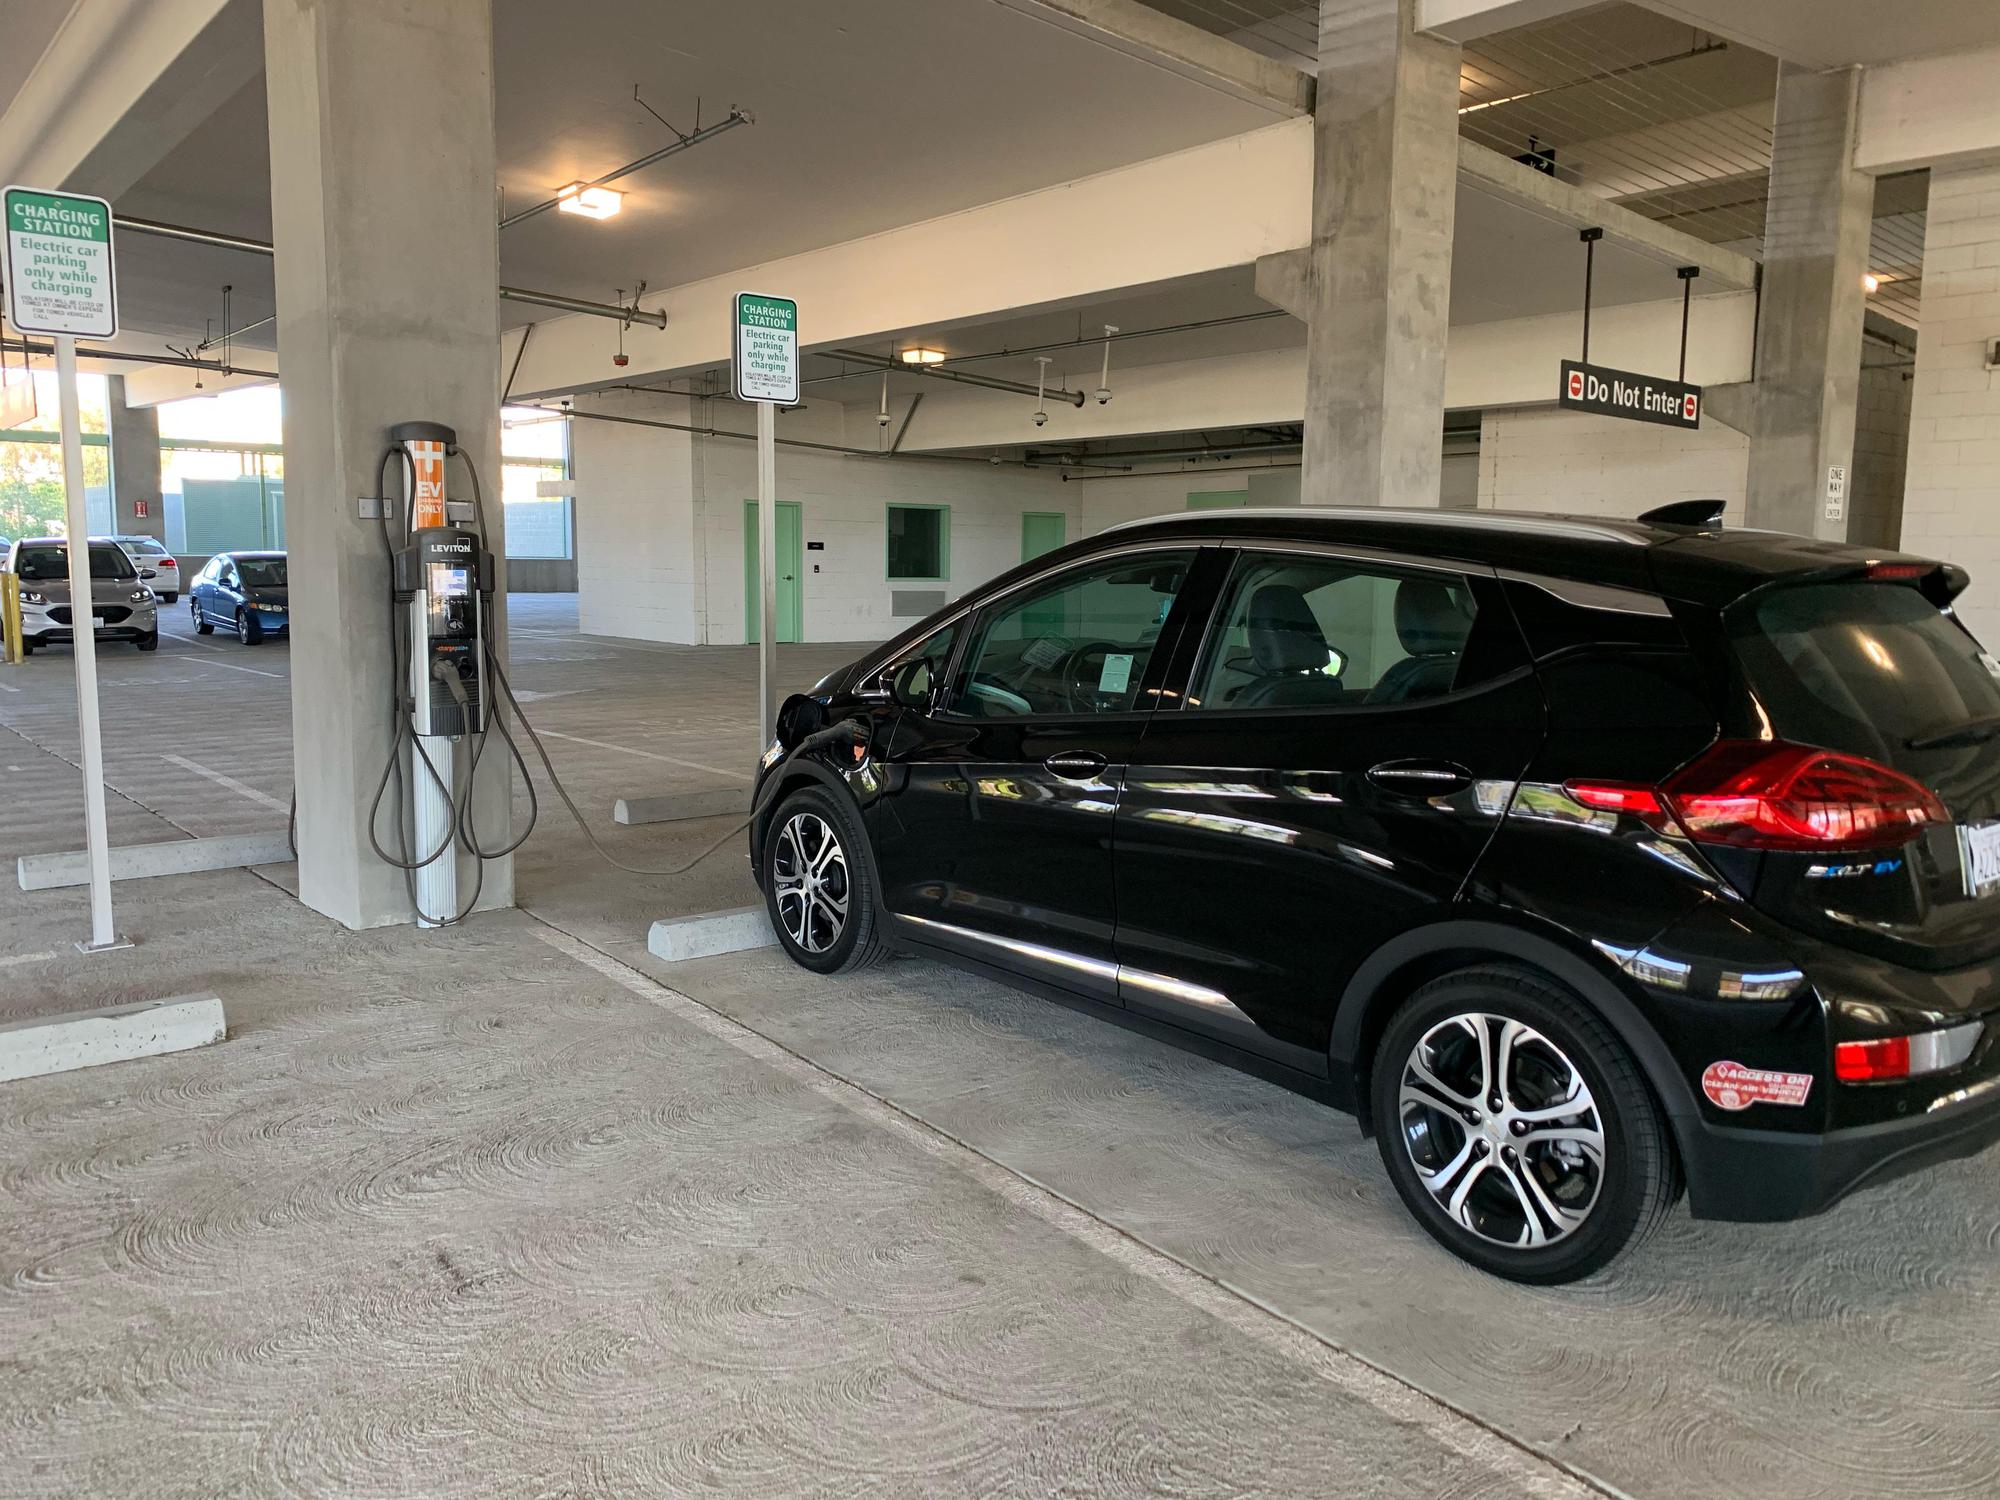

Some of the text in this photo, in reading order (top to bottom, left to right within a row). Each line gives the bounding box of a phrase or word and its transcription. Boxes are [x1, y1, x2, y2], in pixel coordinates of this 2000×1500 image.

[14, 203, 100, 226] CHARGING
[24, 218, 92, 238] STATION
[20, 237, 98, 257] Electric car
[33, 253, 87, 270] parking
[24, 267, 97, 284] only while
[31, 280, 92, 298] charging
[743, 303, 792, 319] CHARGING
[748, 315, 787, 328] STATION
[746, 329, 790, 342] Electric car
[753, 340, 783, 353] parking
[747, 350, 789, 362] only while
[751, 360, 786, 373] charging
[1587, 375, 1682, 415] Do Not Enter
[1830, 468, 1843, 480] ONE
[416, 481, 441, 497] EV
[1829, 482, 1842, 493] WAY
[417, 504, 442, 513] ONLY
[431, 544, 471, 553] LEVITON
[1873, 859, 1902, 876] EV
[1727, 1069, 1809, 1085] ACCESS OK
[1705, 1079, 1738, 1090] CLEAN
[1741, 1084, 1759, 1093] AIR
[1762, 1086, 1804, 1097] VEHICLE
